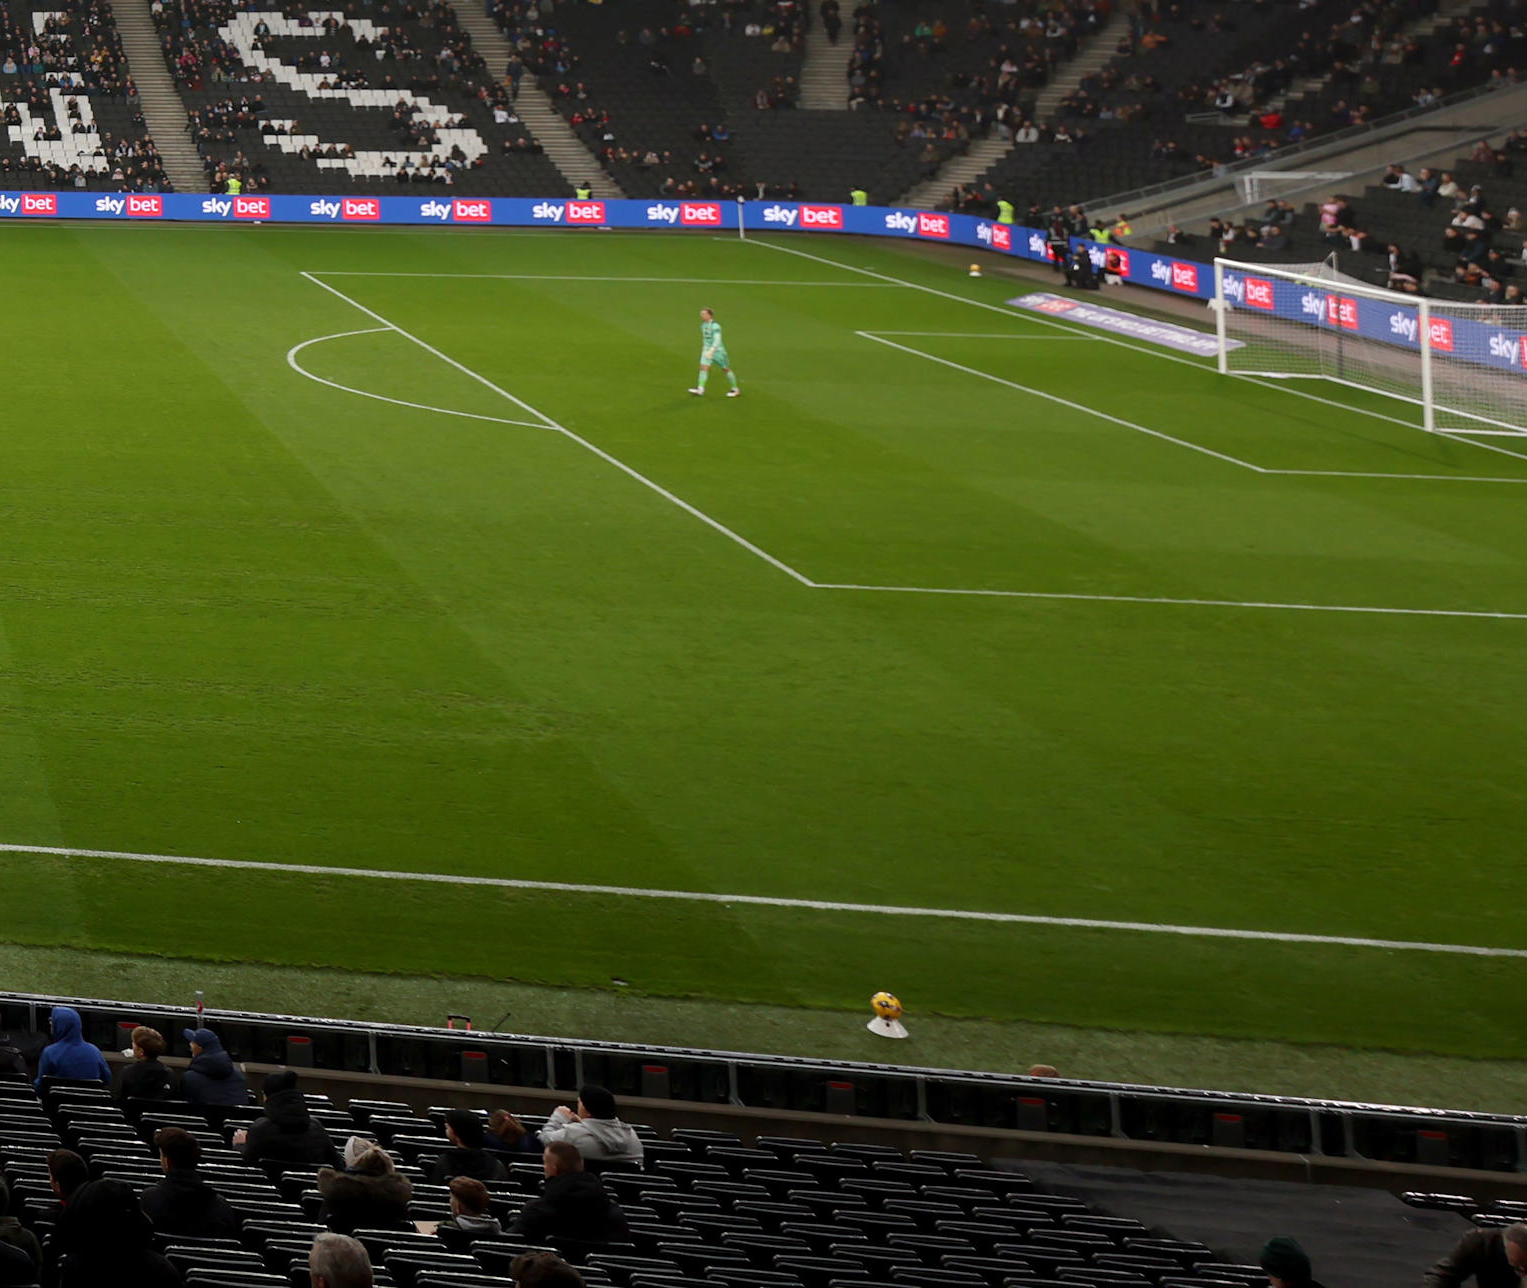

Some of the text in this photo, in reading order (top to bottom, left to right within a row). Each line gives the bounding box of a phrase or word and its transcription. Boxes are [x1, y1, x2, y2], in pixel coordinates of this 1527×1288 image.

[25, 196, 53, 210] bet
[96, 196, 159, 214] sky bet
[202, 198, 266, 216] sky bet
[311, 199, 376, 218] sky bet
[421, 201, 487, 220] sky bet
[533, 202, 601, 221] sky bet
[647, 204, 716, 223] sky bet
[764, 206, 838, 225] sky bet
[886, 212, 946, 233] sky bet
[976, 222, 1009, 245] sky bet
[1152, 260, 1171, 284] sky
[1173, 265, 1195, 286] bet
[1223, 275, 1270, 304] sky bet
